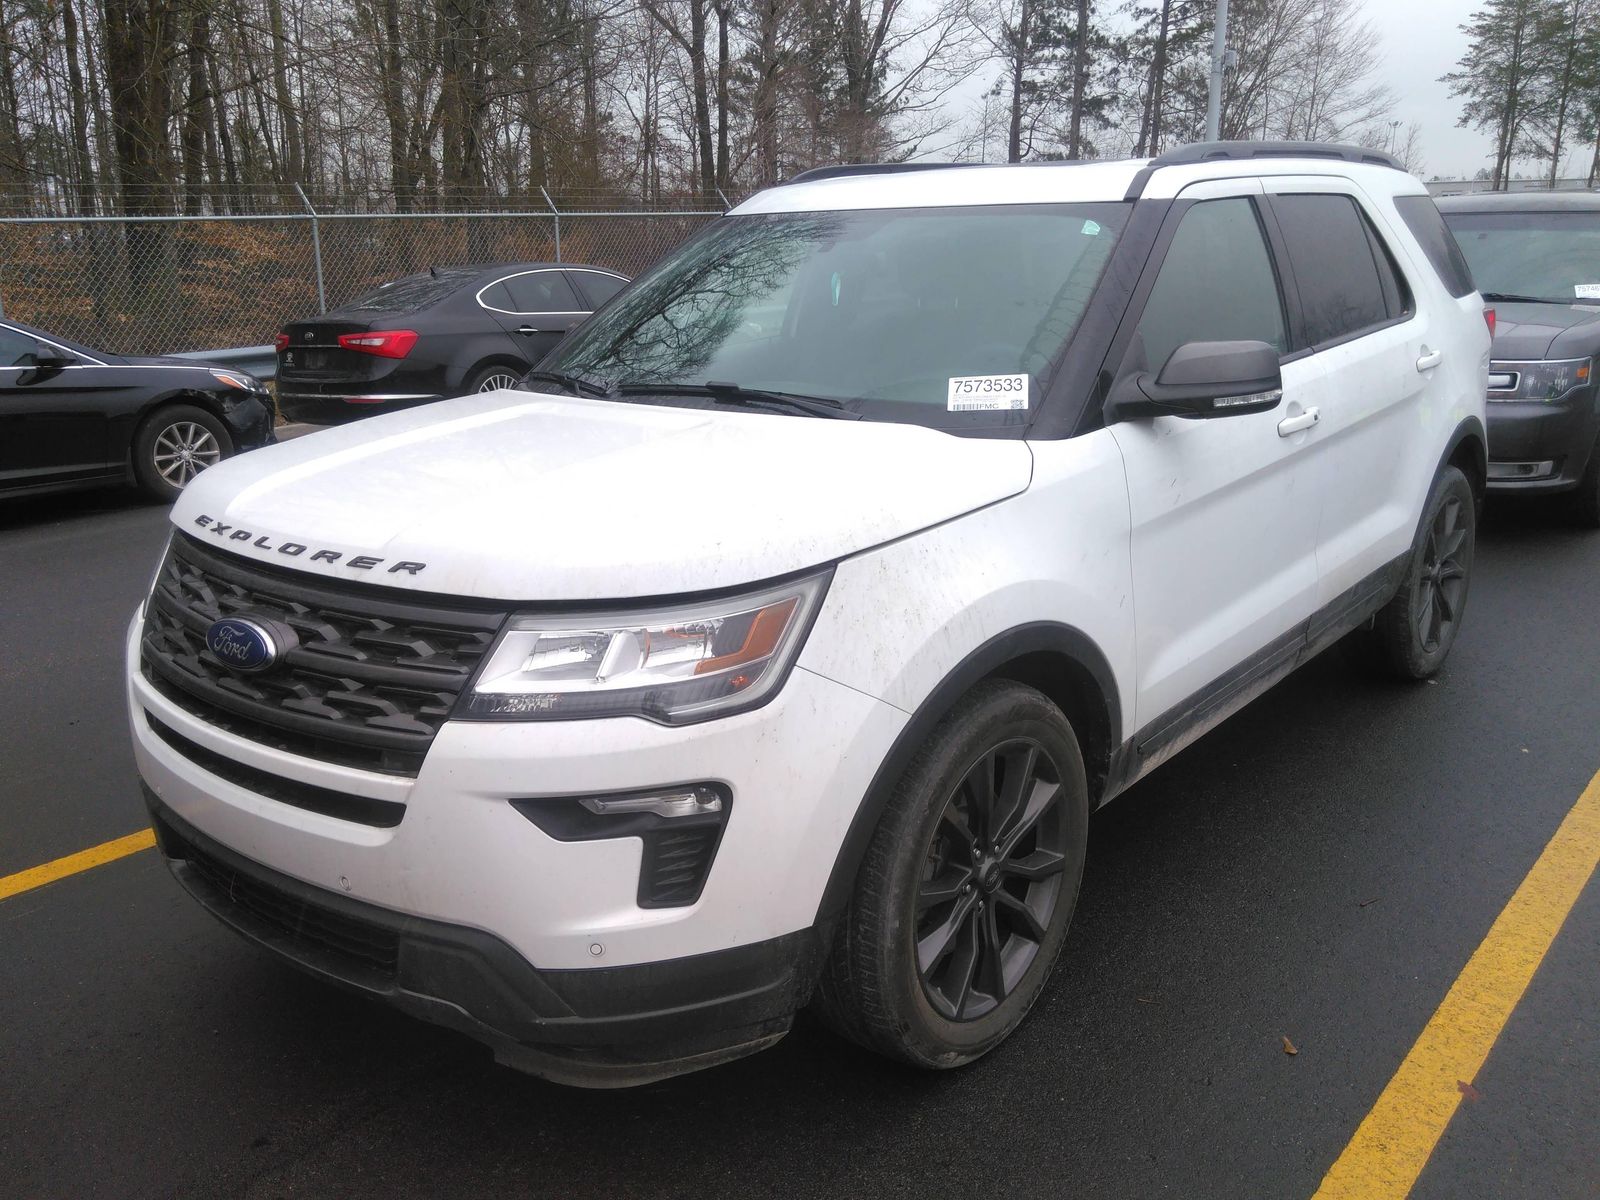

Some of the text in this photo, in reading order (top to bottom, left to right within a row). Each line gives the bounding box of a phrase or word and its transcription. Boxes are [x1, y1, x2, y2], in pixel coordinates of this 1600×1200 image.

[953, 378, 1023, 394] 7573533
[194, 514, 426, 575] EXPLORER
[213, 625, 252, 660] Ford
